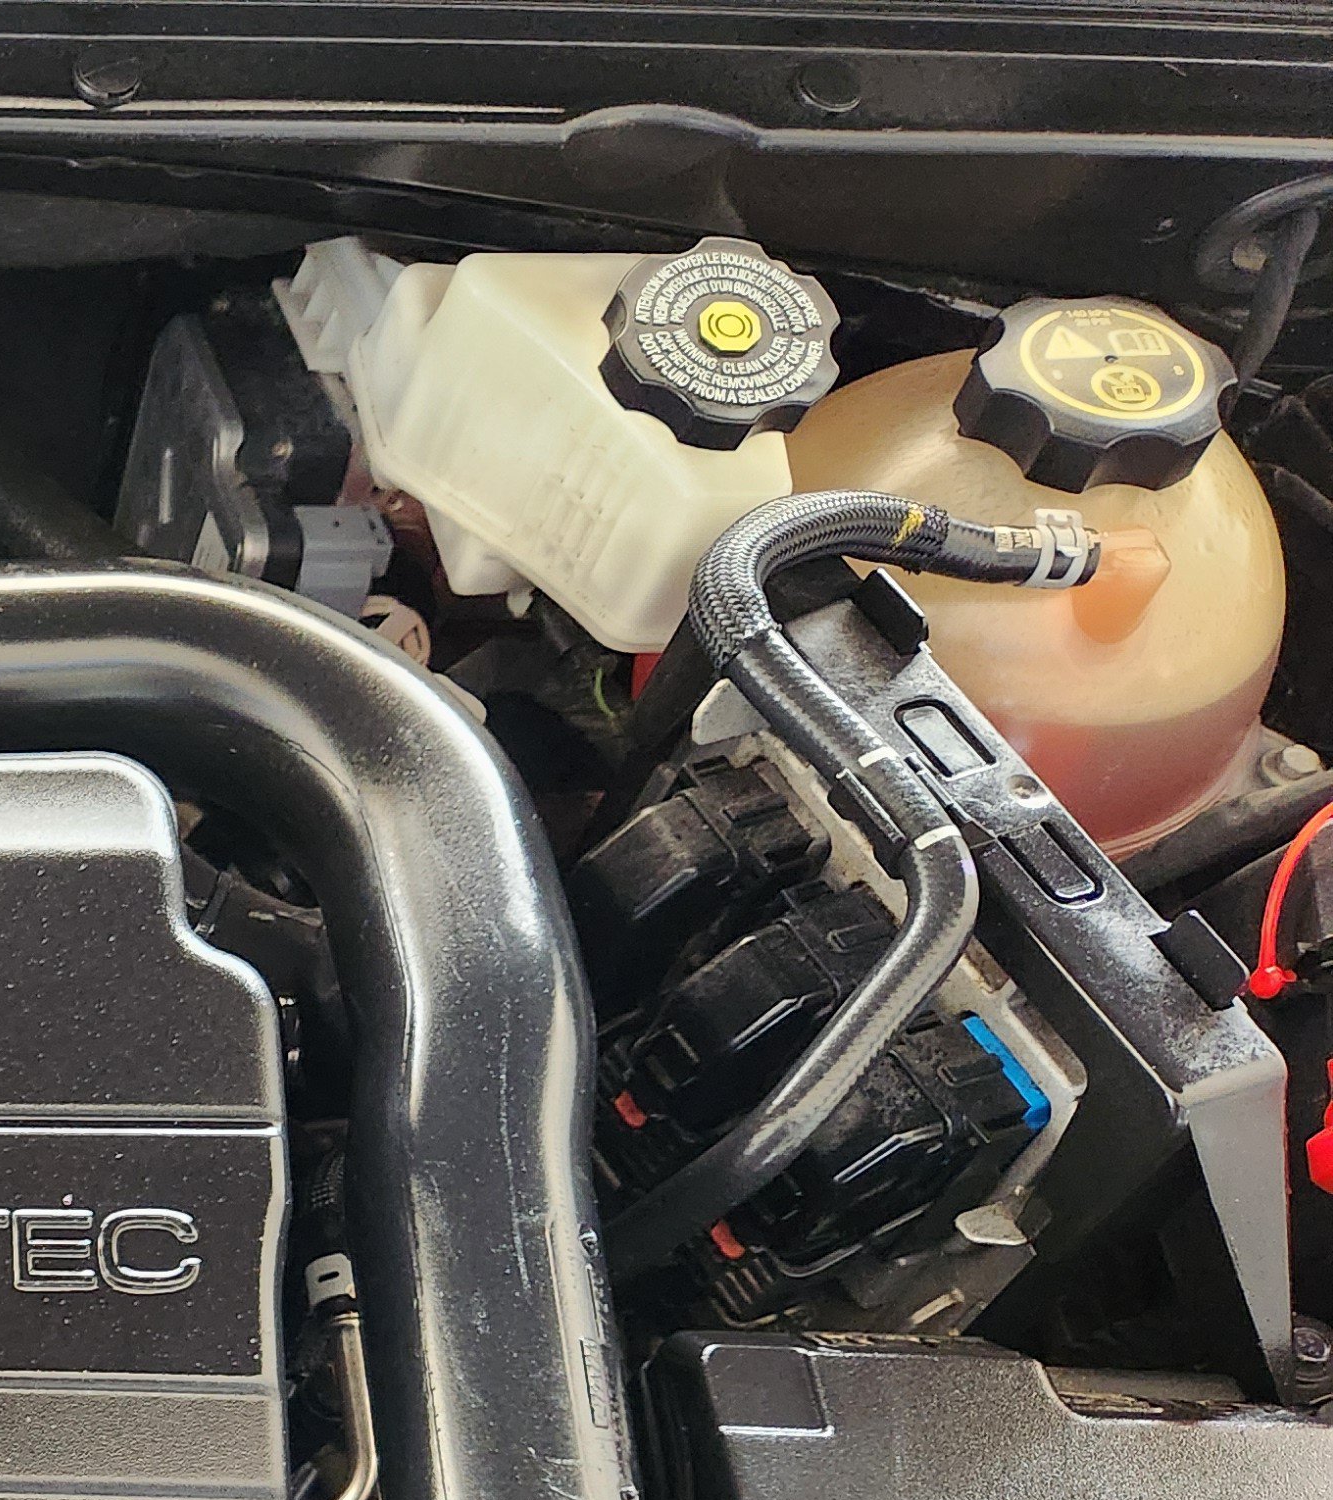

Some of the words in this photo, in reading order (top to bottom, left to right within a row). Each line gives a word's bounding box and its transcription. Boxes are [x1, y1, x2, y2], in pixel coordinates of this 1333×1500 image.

[701, 265, 718, 279] DU
[755, 275, 773, 291] DE
[704, 252, 720, 265] LE
[720, 252, 771, 275] BOUCHON
[767, 267, 803, 295] AVANT
[655, 331, 678, 352] CAP
[668, 349, 713, 383] BEFORE
[785, 337, 807, 365] ONLY
[722, 359, 764, 375] CLEAN
[759, 336, 789, 368] FILLER
[655, 358, 691, 387] FLUID
[688, 379, 727, 402] FROM
[725, 389, 738, 404] A
[737, 384, 786, 404] SEALED
